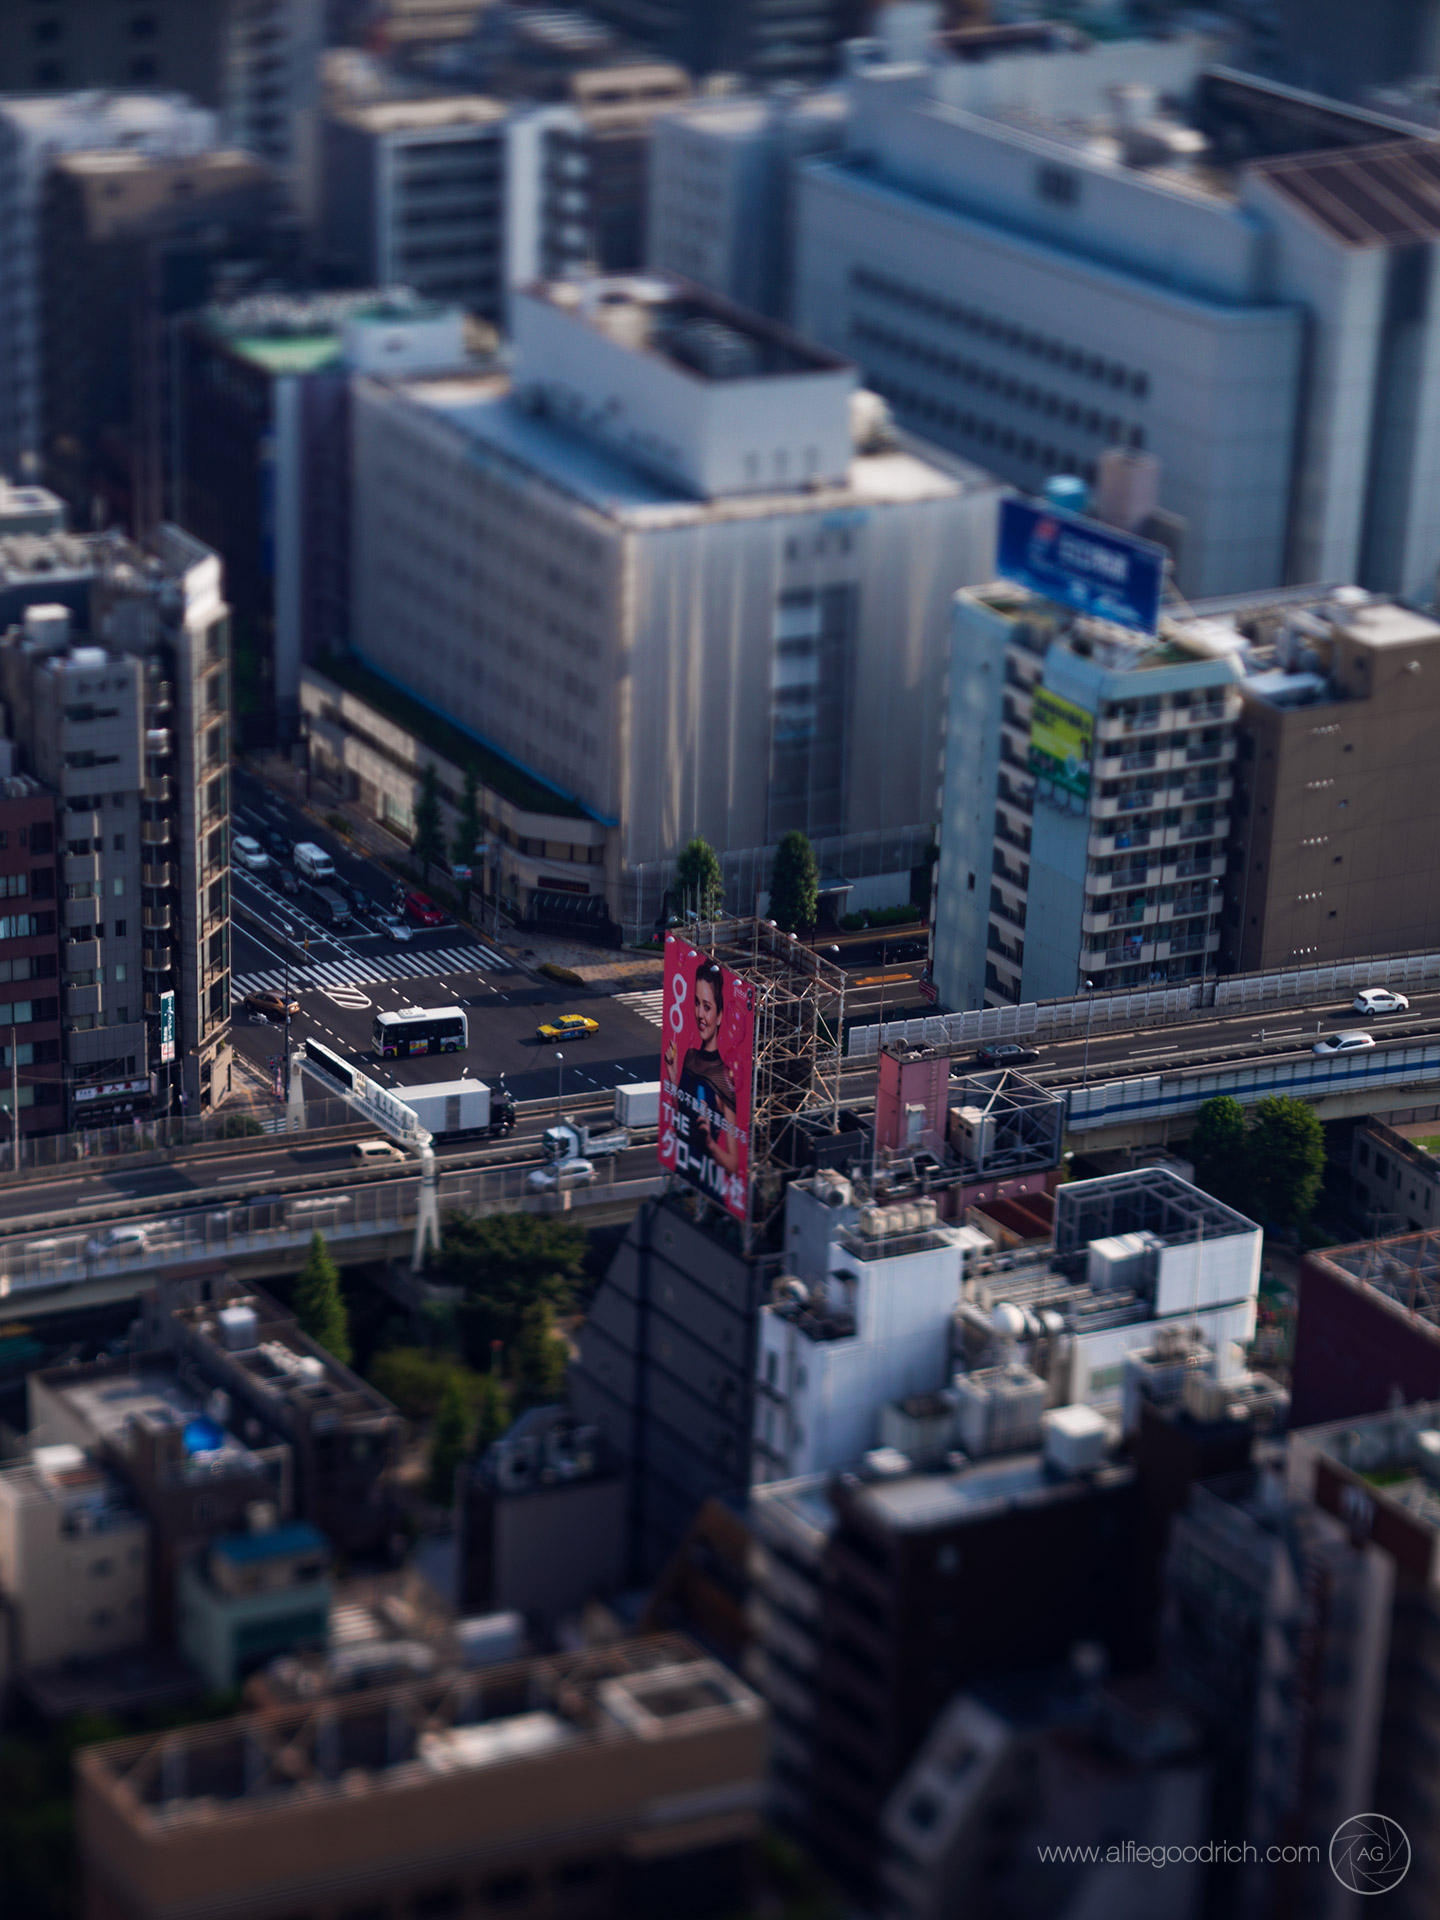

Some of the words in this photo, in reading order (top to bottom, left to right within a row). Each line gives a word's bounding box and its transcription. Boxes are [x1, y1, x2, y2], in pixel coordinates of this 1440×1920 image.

[662, 1100, 691, 1137] THE
[661, 1127, 746, 1210] グローバル社
